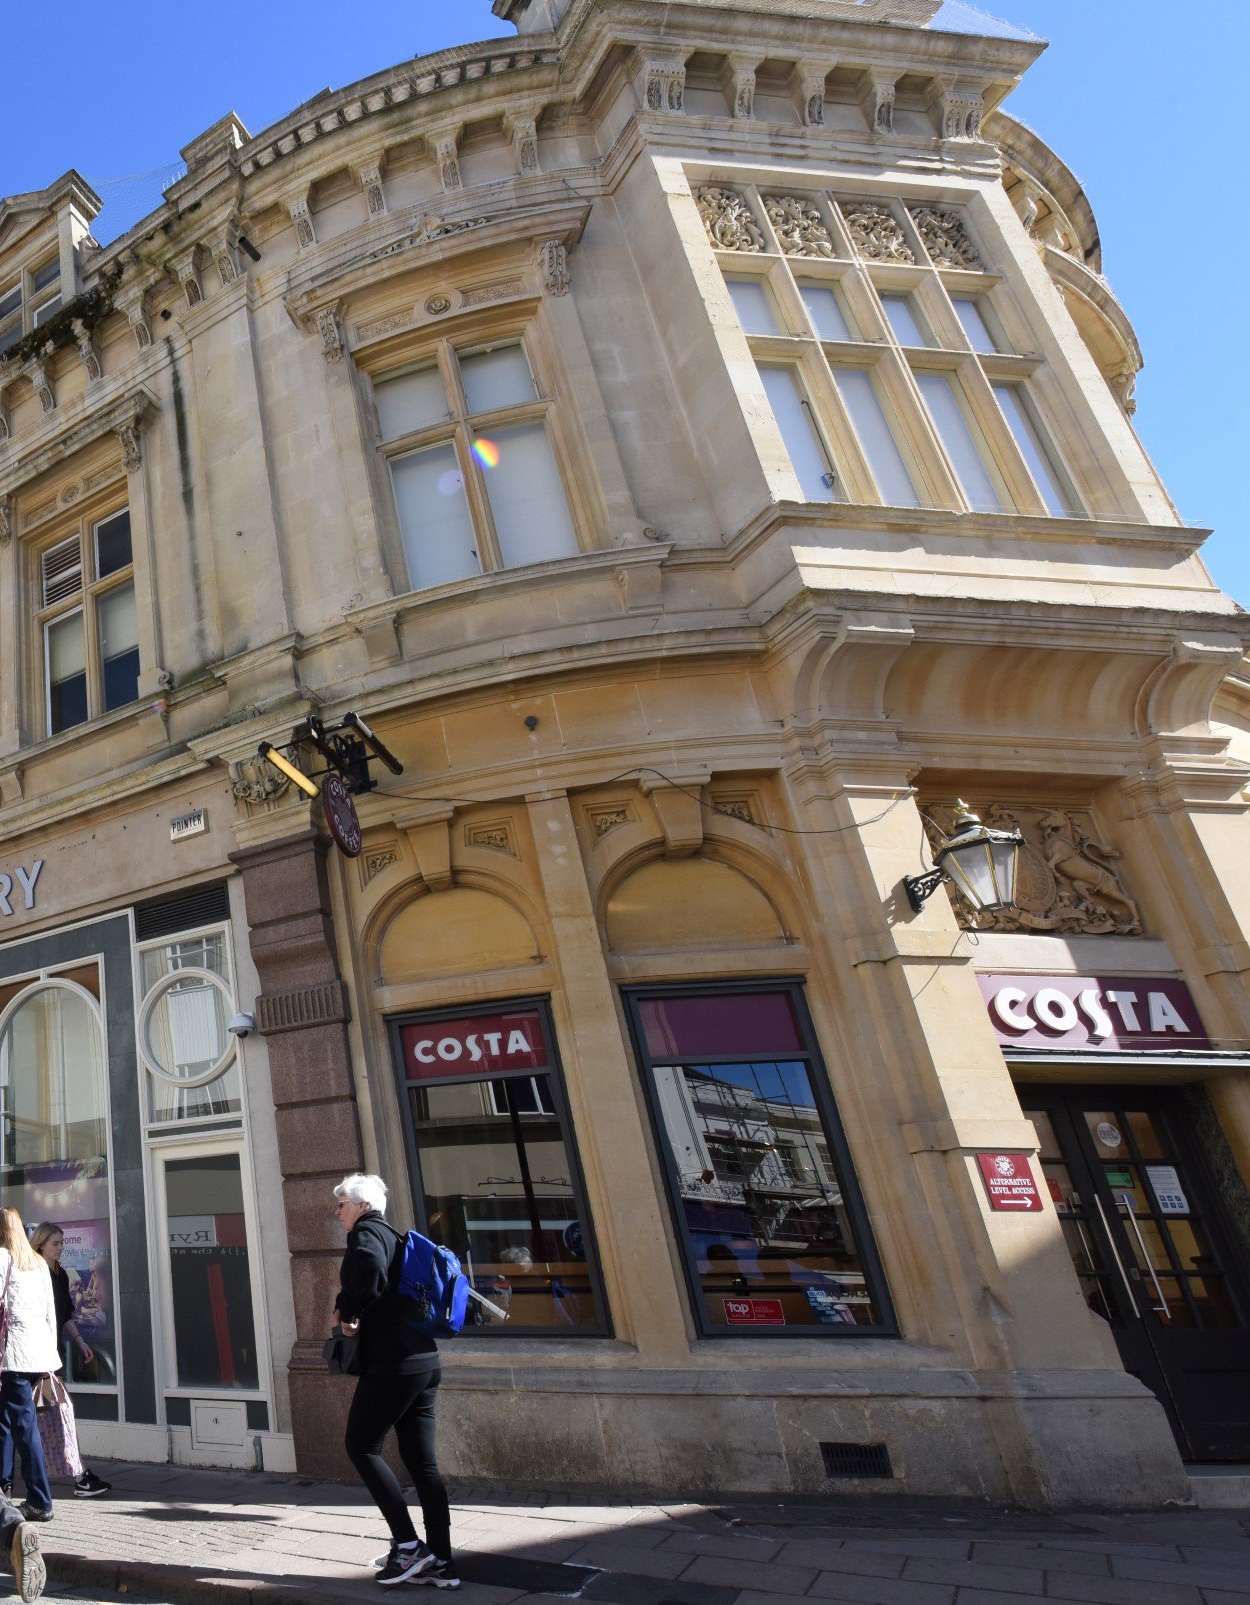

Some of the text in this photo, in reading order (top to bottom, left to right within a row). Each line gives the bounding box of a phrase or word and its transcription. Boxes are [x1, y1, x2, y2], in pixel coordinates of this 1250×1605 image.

[172, 814, 202, 833] POINTER
[334, 814, 360, 848] COFFEE
[994, 987, 1190, 1038] COSTA
[414, 1029, 532, 1064] COSTA
[990, 1178, 1031, 1186] ALTERNATIVE
[727, 1302, 750, 1315] top
